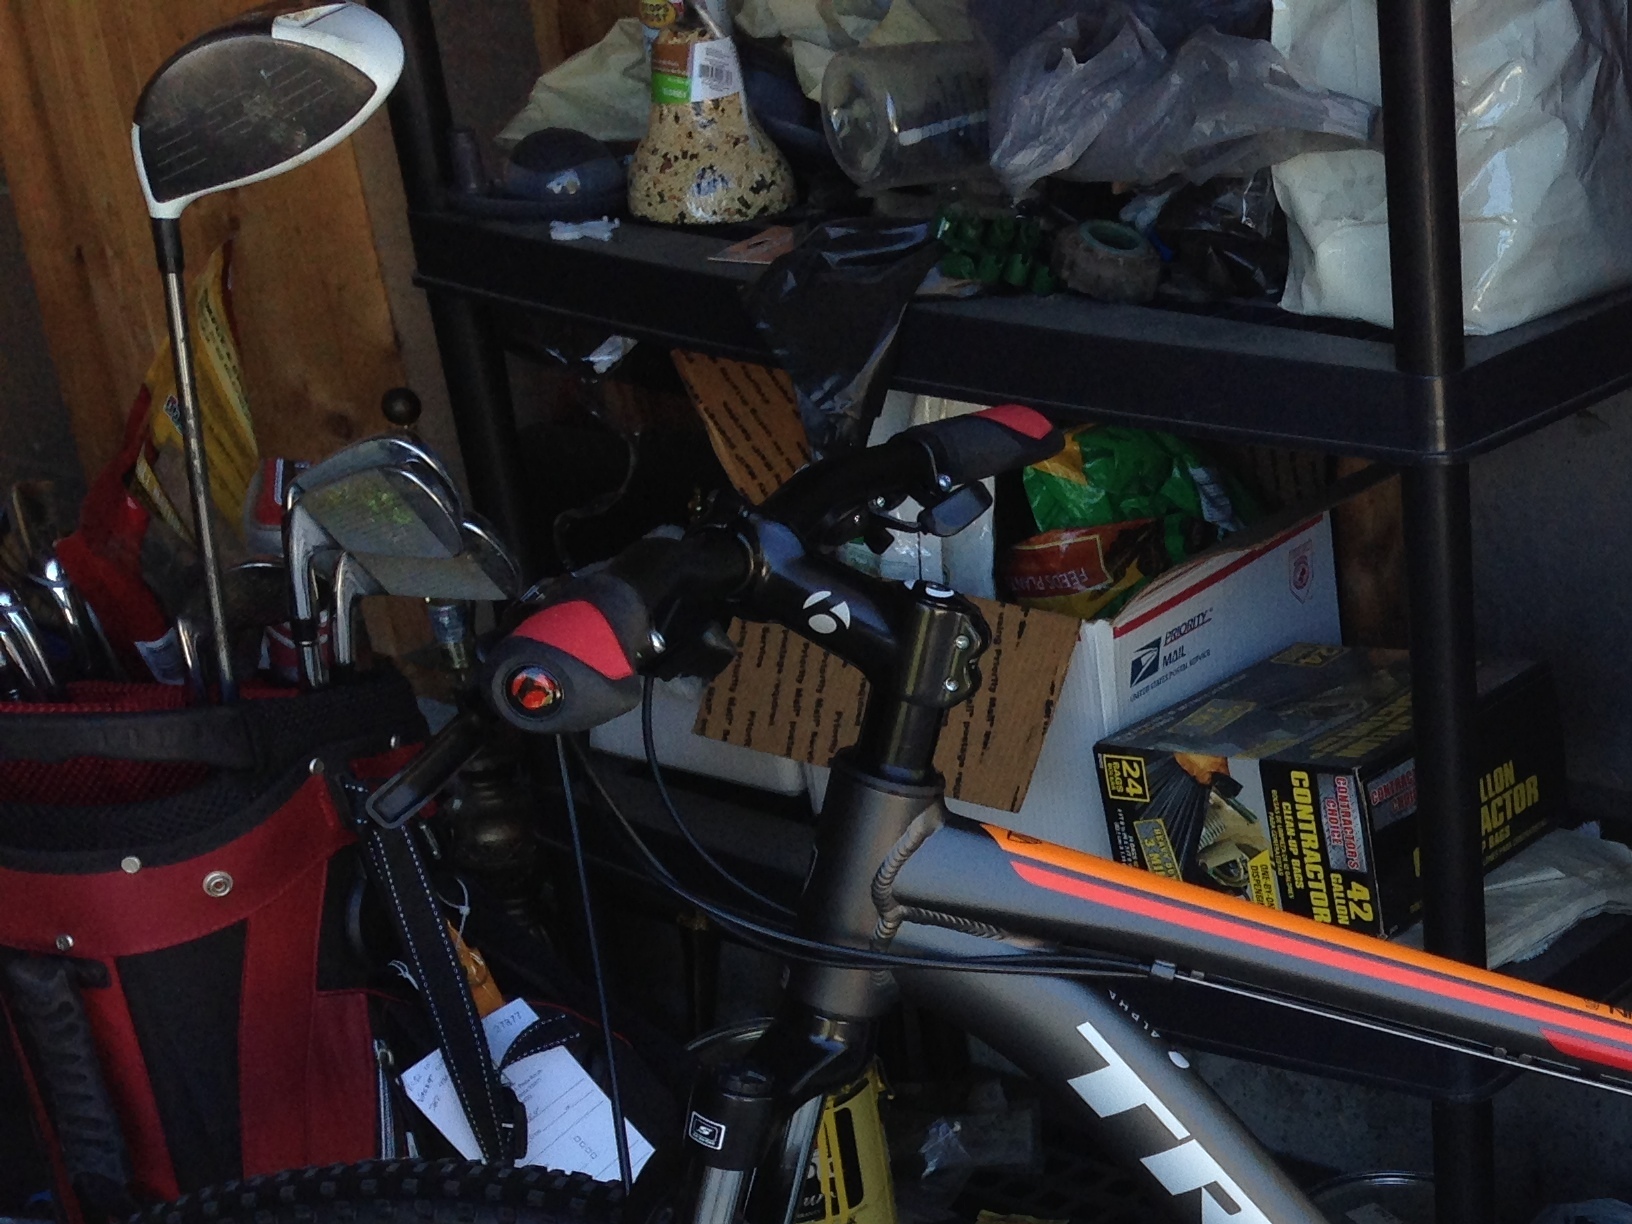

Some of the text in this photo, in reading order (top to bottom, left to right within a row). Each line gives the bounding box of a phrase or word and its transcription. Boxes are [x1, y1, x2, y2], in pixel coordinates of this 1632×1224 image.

[1165, 610, 1208, 645] PRIORITY
[1163, 645, 1186, 667] MAIL
[1112, 761, 1124, 793] BAGS
[1122, 760, 1143, 797] 24
[1370, 768, 1417, 806] CONTRAC
[1480, 760, 1515, 804] LLON
[1325, 798, 1343, 845] CHOICE
[1335, 776, 1360, 870] CONTRACTOR'S
[1481, 775, 1539, 837] ACTOR
[1144, 838, 1155, 848] 3
[1282, 801, 1304, 889] CLEAN-UP BAGS
[1290, 770, 1331, 924] CONTRACTOR
[1260, 865, 1275, 909] ONE-BY-ON
[1330, 873, 1349, 925] GALLON
[1347, 881, 1374, 922] 42
[1107, 989, 1161, 1039] ALPHA
